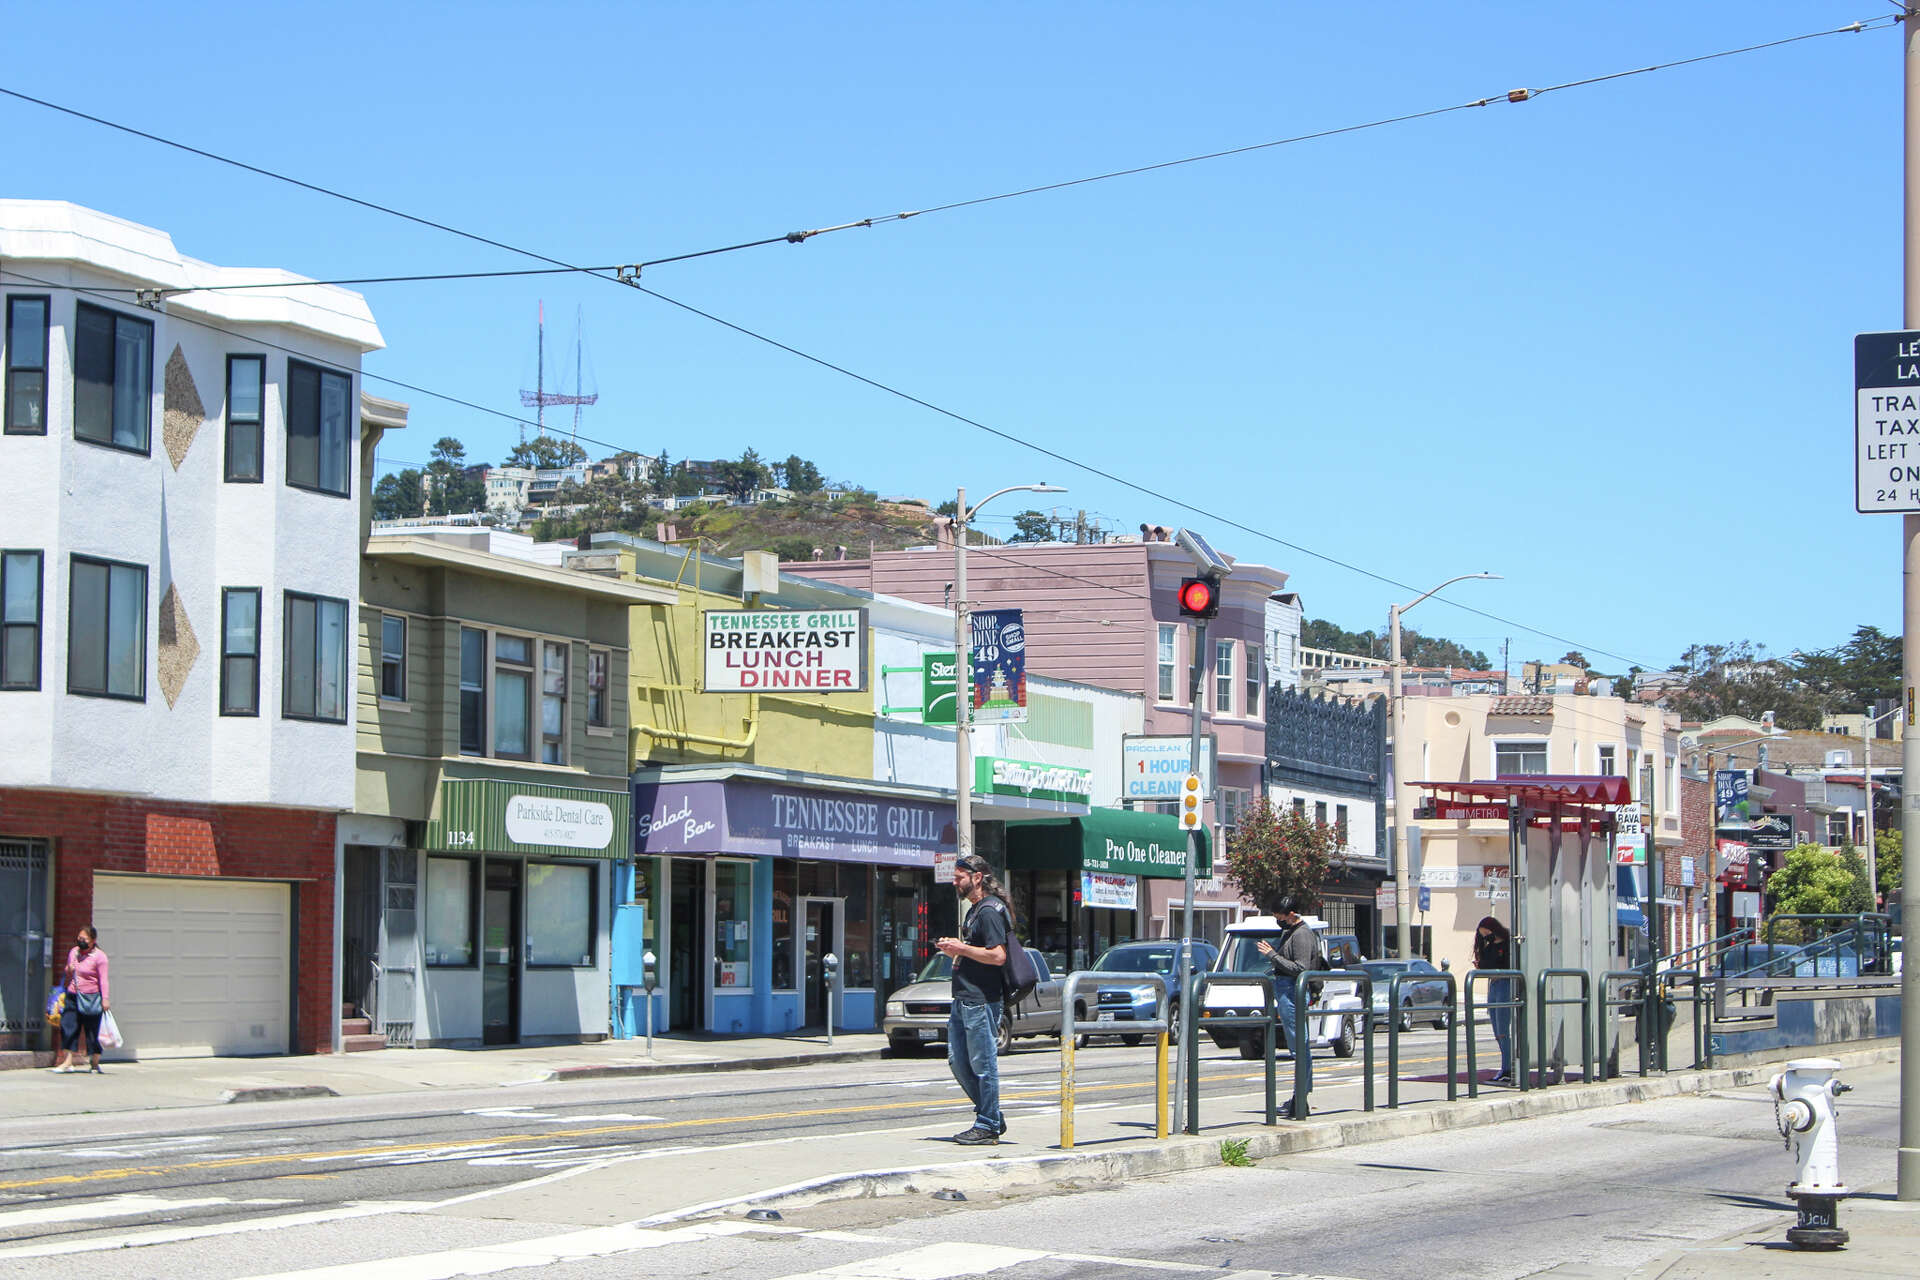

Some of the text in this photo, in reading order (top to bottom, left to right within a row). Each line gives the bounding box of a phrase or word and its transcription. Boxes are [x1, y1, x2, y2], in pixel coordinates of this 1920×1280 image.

[1871, 395, 1920, 412] TRA
[1868, 443, 1908, 460] LEFT
[1877, 489, 1897, 501] 24
[710, 613, 856, 630] TENNESSEE GRILL
[973, 616, 997, 630] SHOP
[710, 631, 856, 649] BREAKFAST
[974, 630, 998, 646] DINE
[726, 650, 823, 668] LUNCH
[974, 645, 1000, 662] 49
[740, 669, 852, 687] DINNER
[1138, 759, 1191, 774] 1 HOUR
[1129, 780, 1183, 796] CLEANI
[1718, 789, 1734, 799] 49
[517, 803, 604, 826] Parkside Dental Care
[639, 795, 692, 838] Salad
[771, 793, 939, 842] TENNESSEE GRILL
[1465, 808, 1500, 819] METRO
[683, 817, 716, 845] Bar
[1619, 824, 1638, 834] AFE
[448, 831, 474, 845] 1134
[787, 833, 922, 857] BREAKFAST LUNCH DINNER
[1105, 838, 1187, 866] Pro One Cleaner
